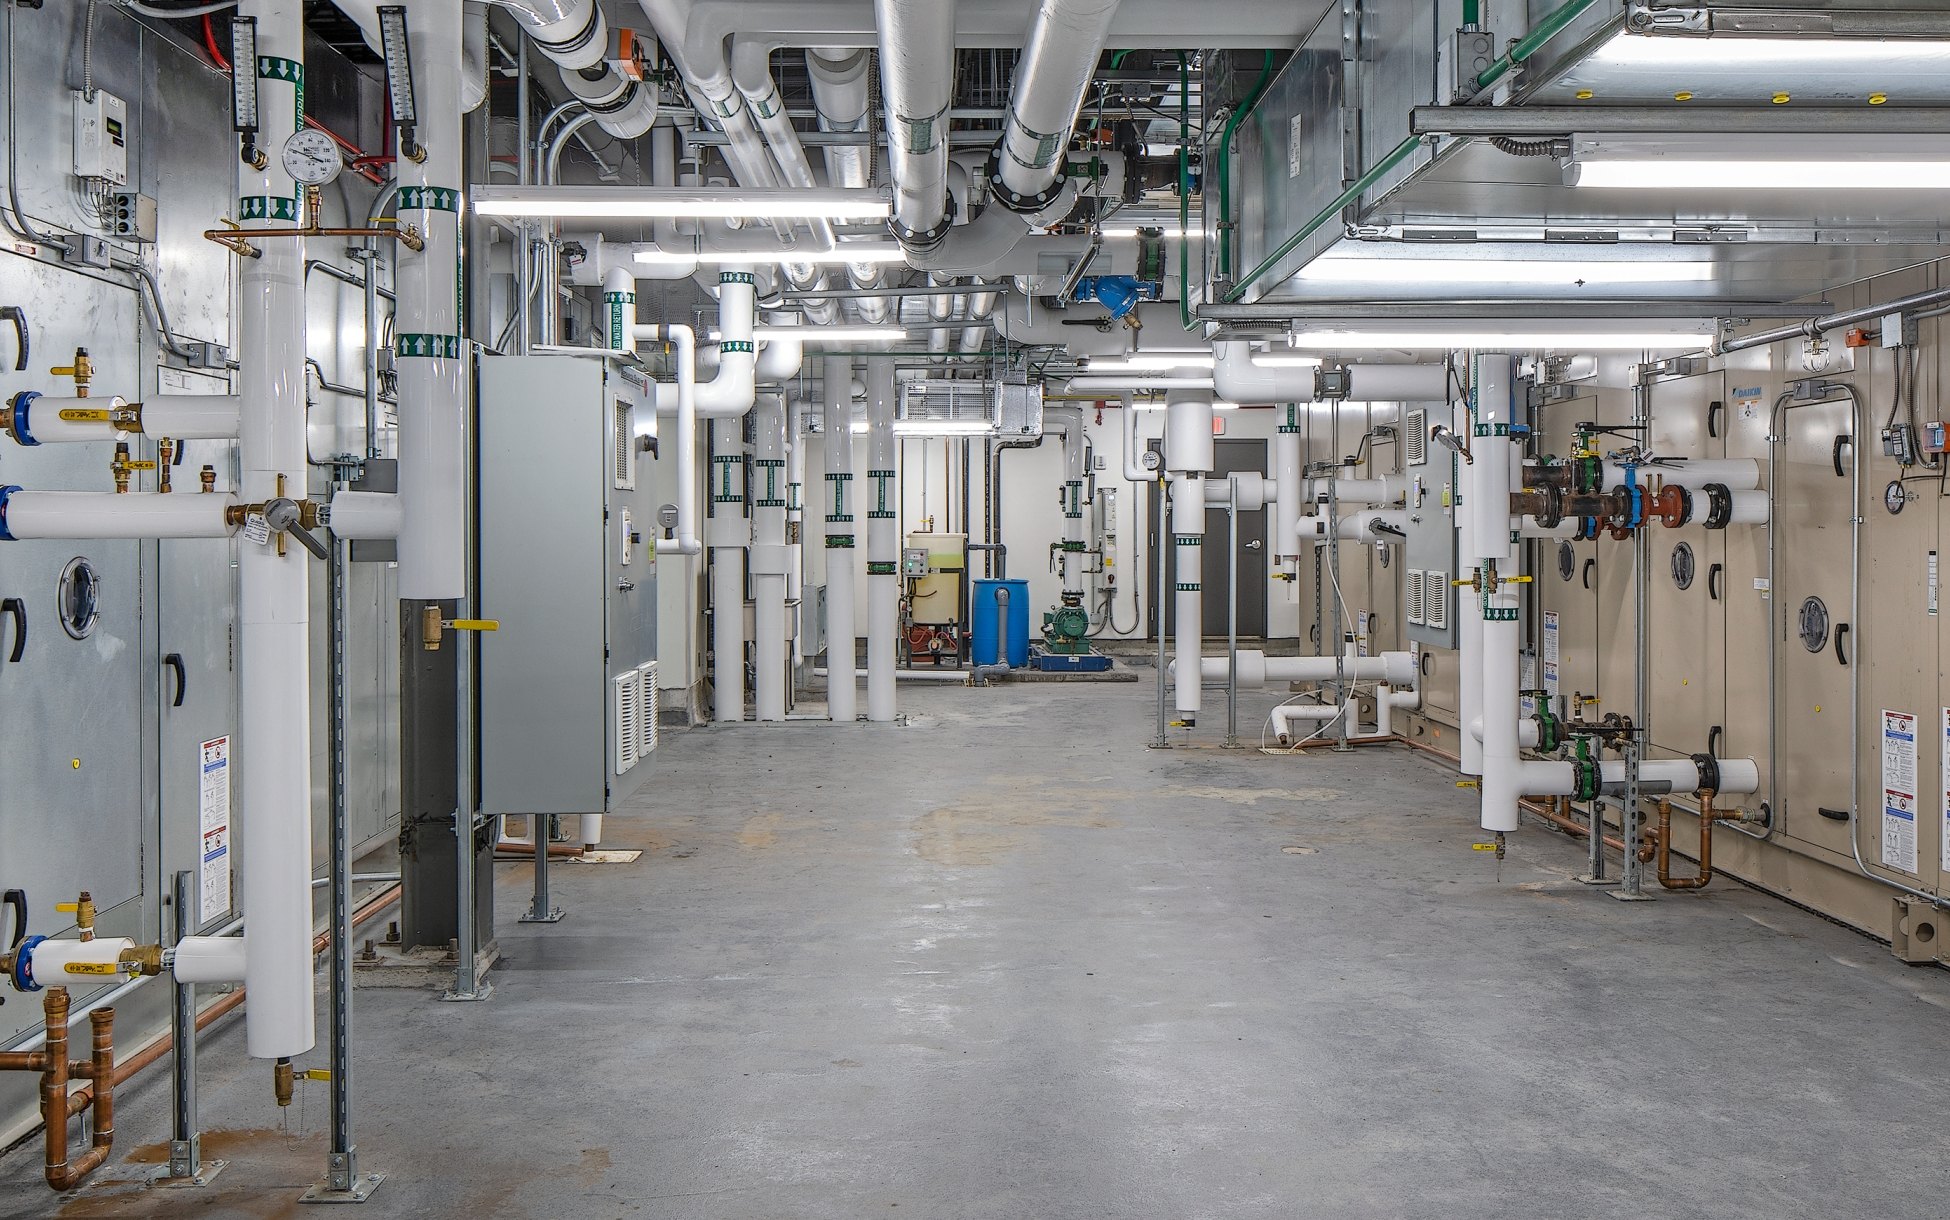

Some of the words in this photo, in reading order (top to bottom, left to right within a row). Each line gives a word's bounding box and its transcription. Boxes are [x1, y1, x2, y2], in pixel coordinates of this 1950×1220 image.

[613, 304, 621, 323] RETURN
[613, 324, 621, 340] WATER
[1739, 388, 1760, 397] DAIKIN
